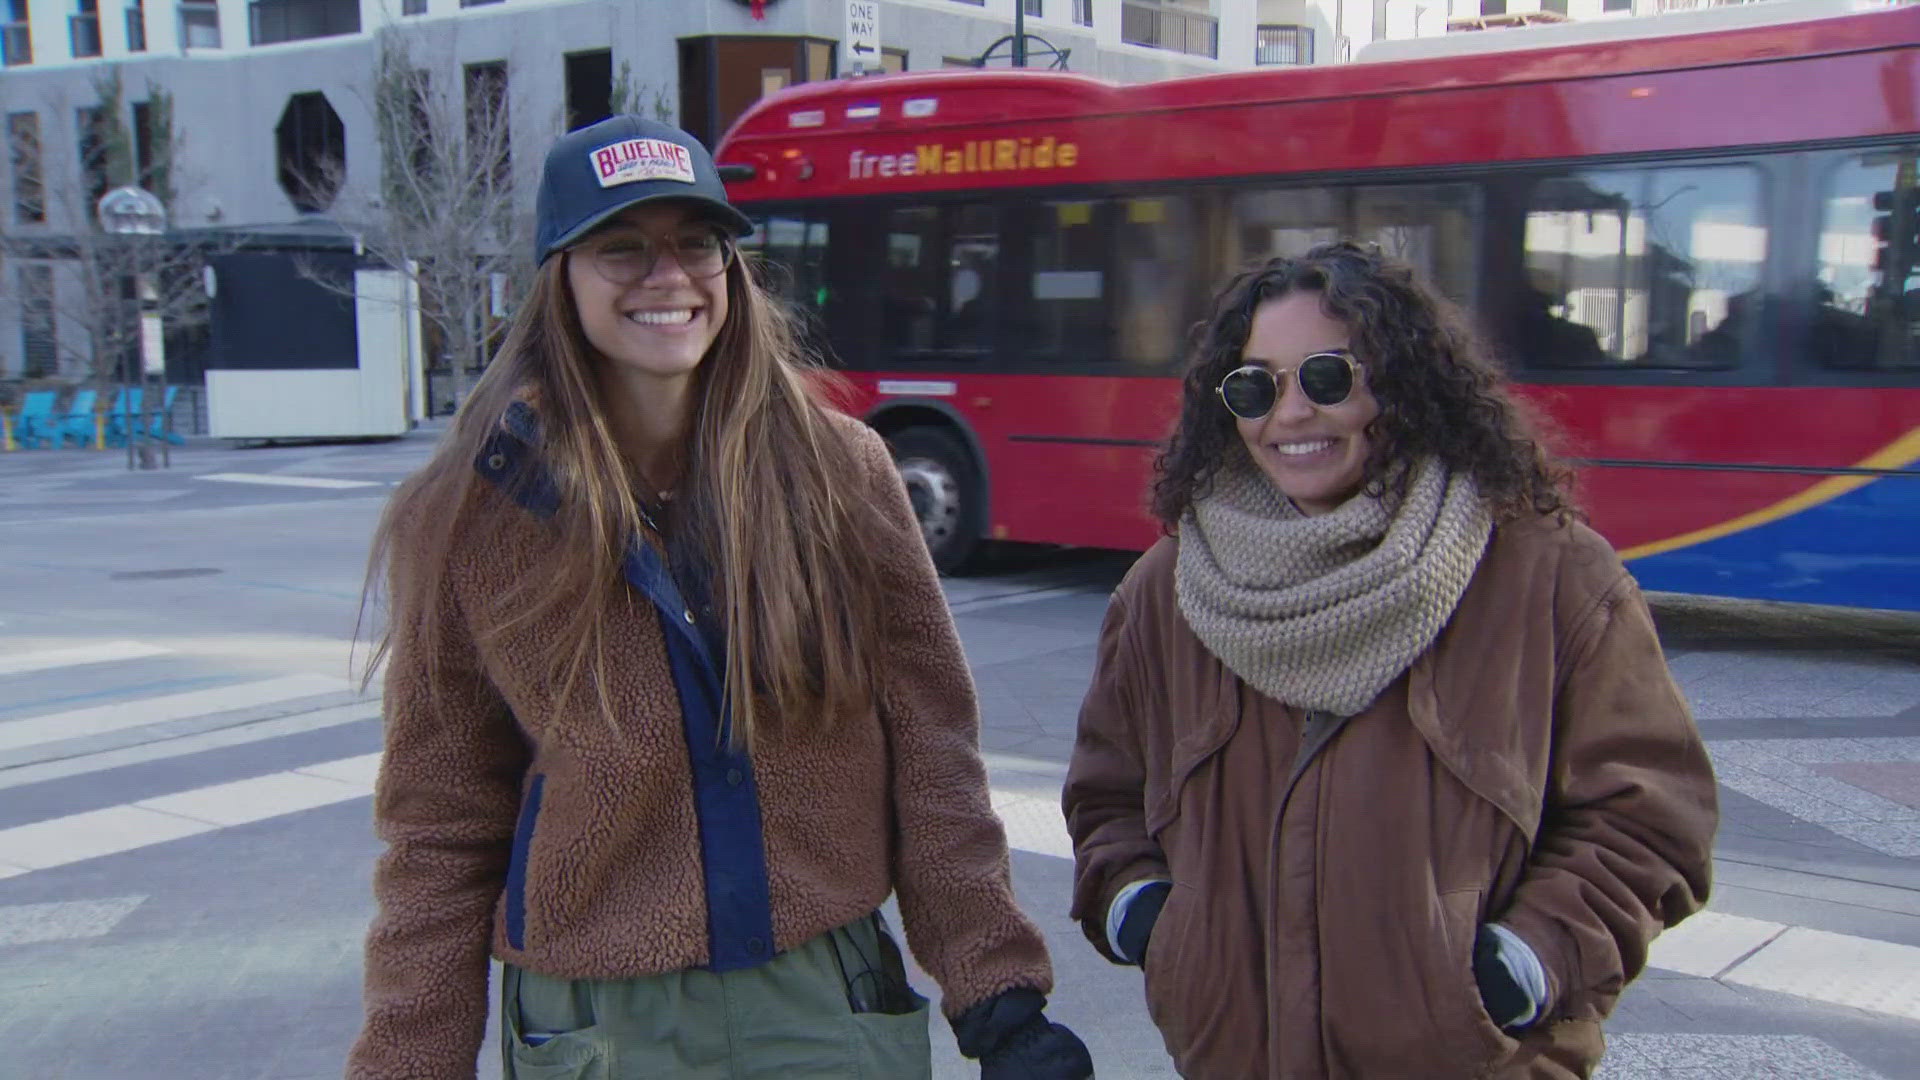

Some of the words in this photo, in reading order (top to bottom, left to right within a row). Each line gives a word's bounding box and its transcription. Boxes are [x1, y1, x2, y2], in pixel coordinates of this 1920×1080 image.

[850, 3, 873, 20] ONE
[851, 21, 874, 36] WAY
[597, 141, 690, 179] BLUELINE
[849, 136, 1078, 179] freeMallRide
